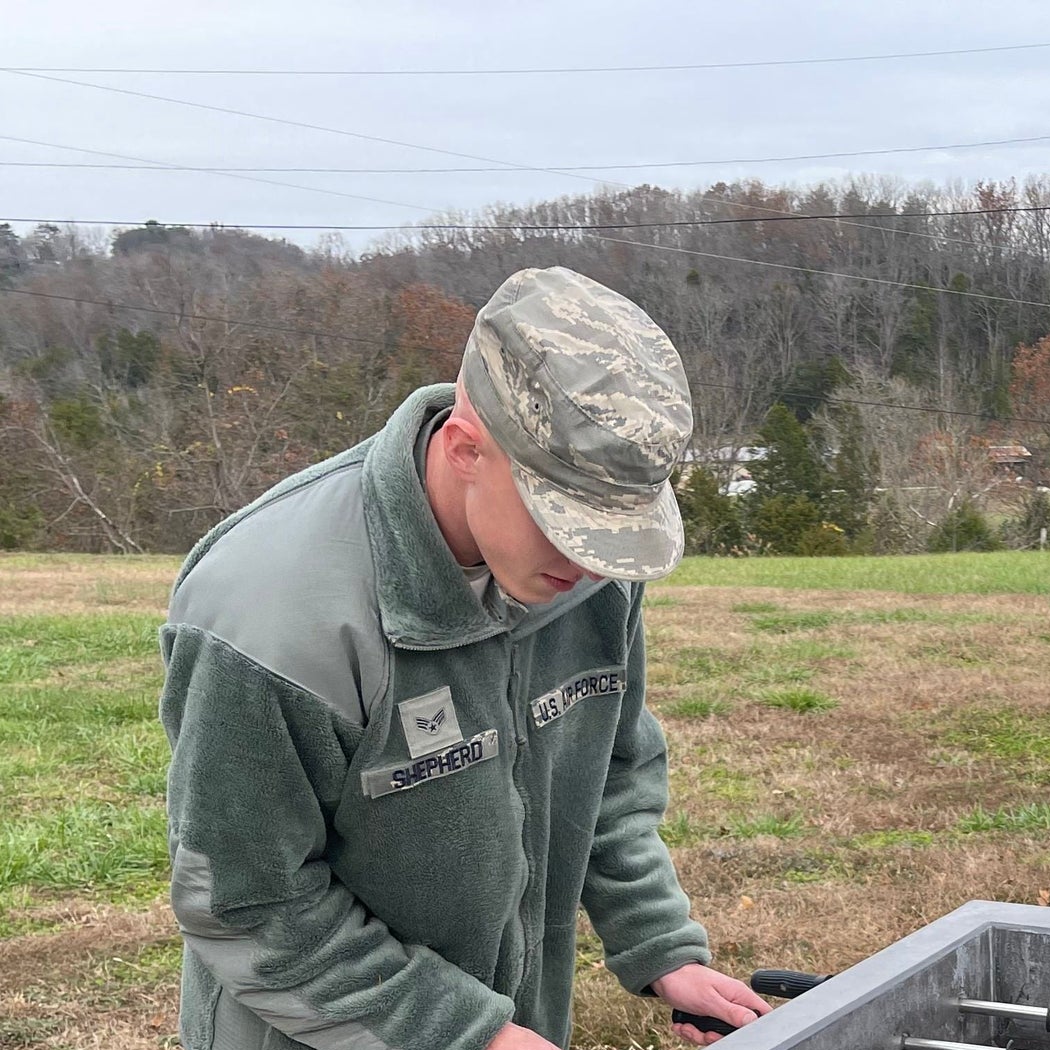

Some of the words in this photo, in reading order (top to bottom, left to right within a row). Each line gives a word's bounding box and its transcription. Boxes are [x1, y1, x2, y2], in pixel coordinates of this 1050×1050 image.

[538, 699, 562, 722] U.S.
[575, 673, 619, 702] FORCE
[392, 740, 483, 789] SHEPHERD
